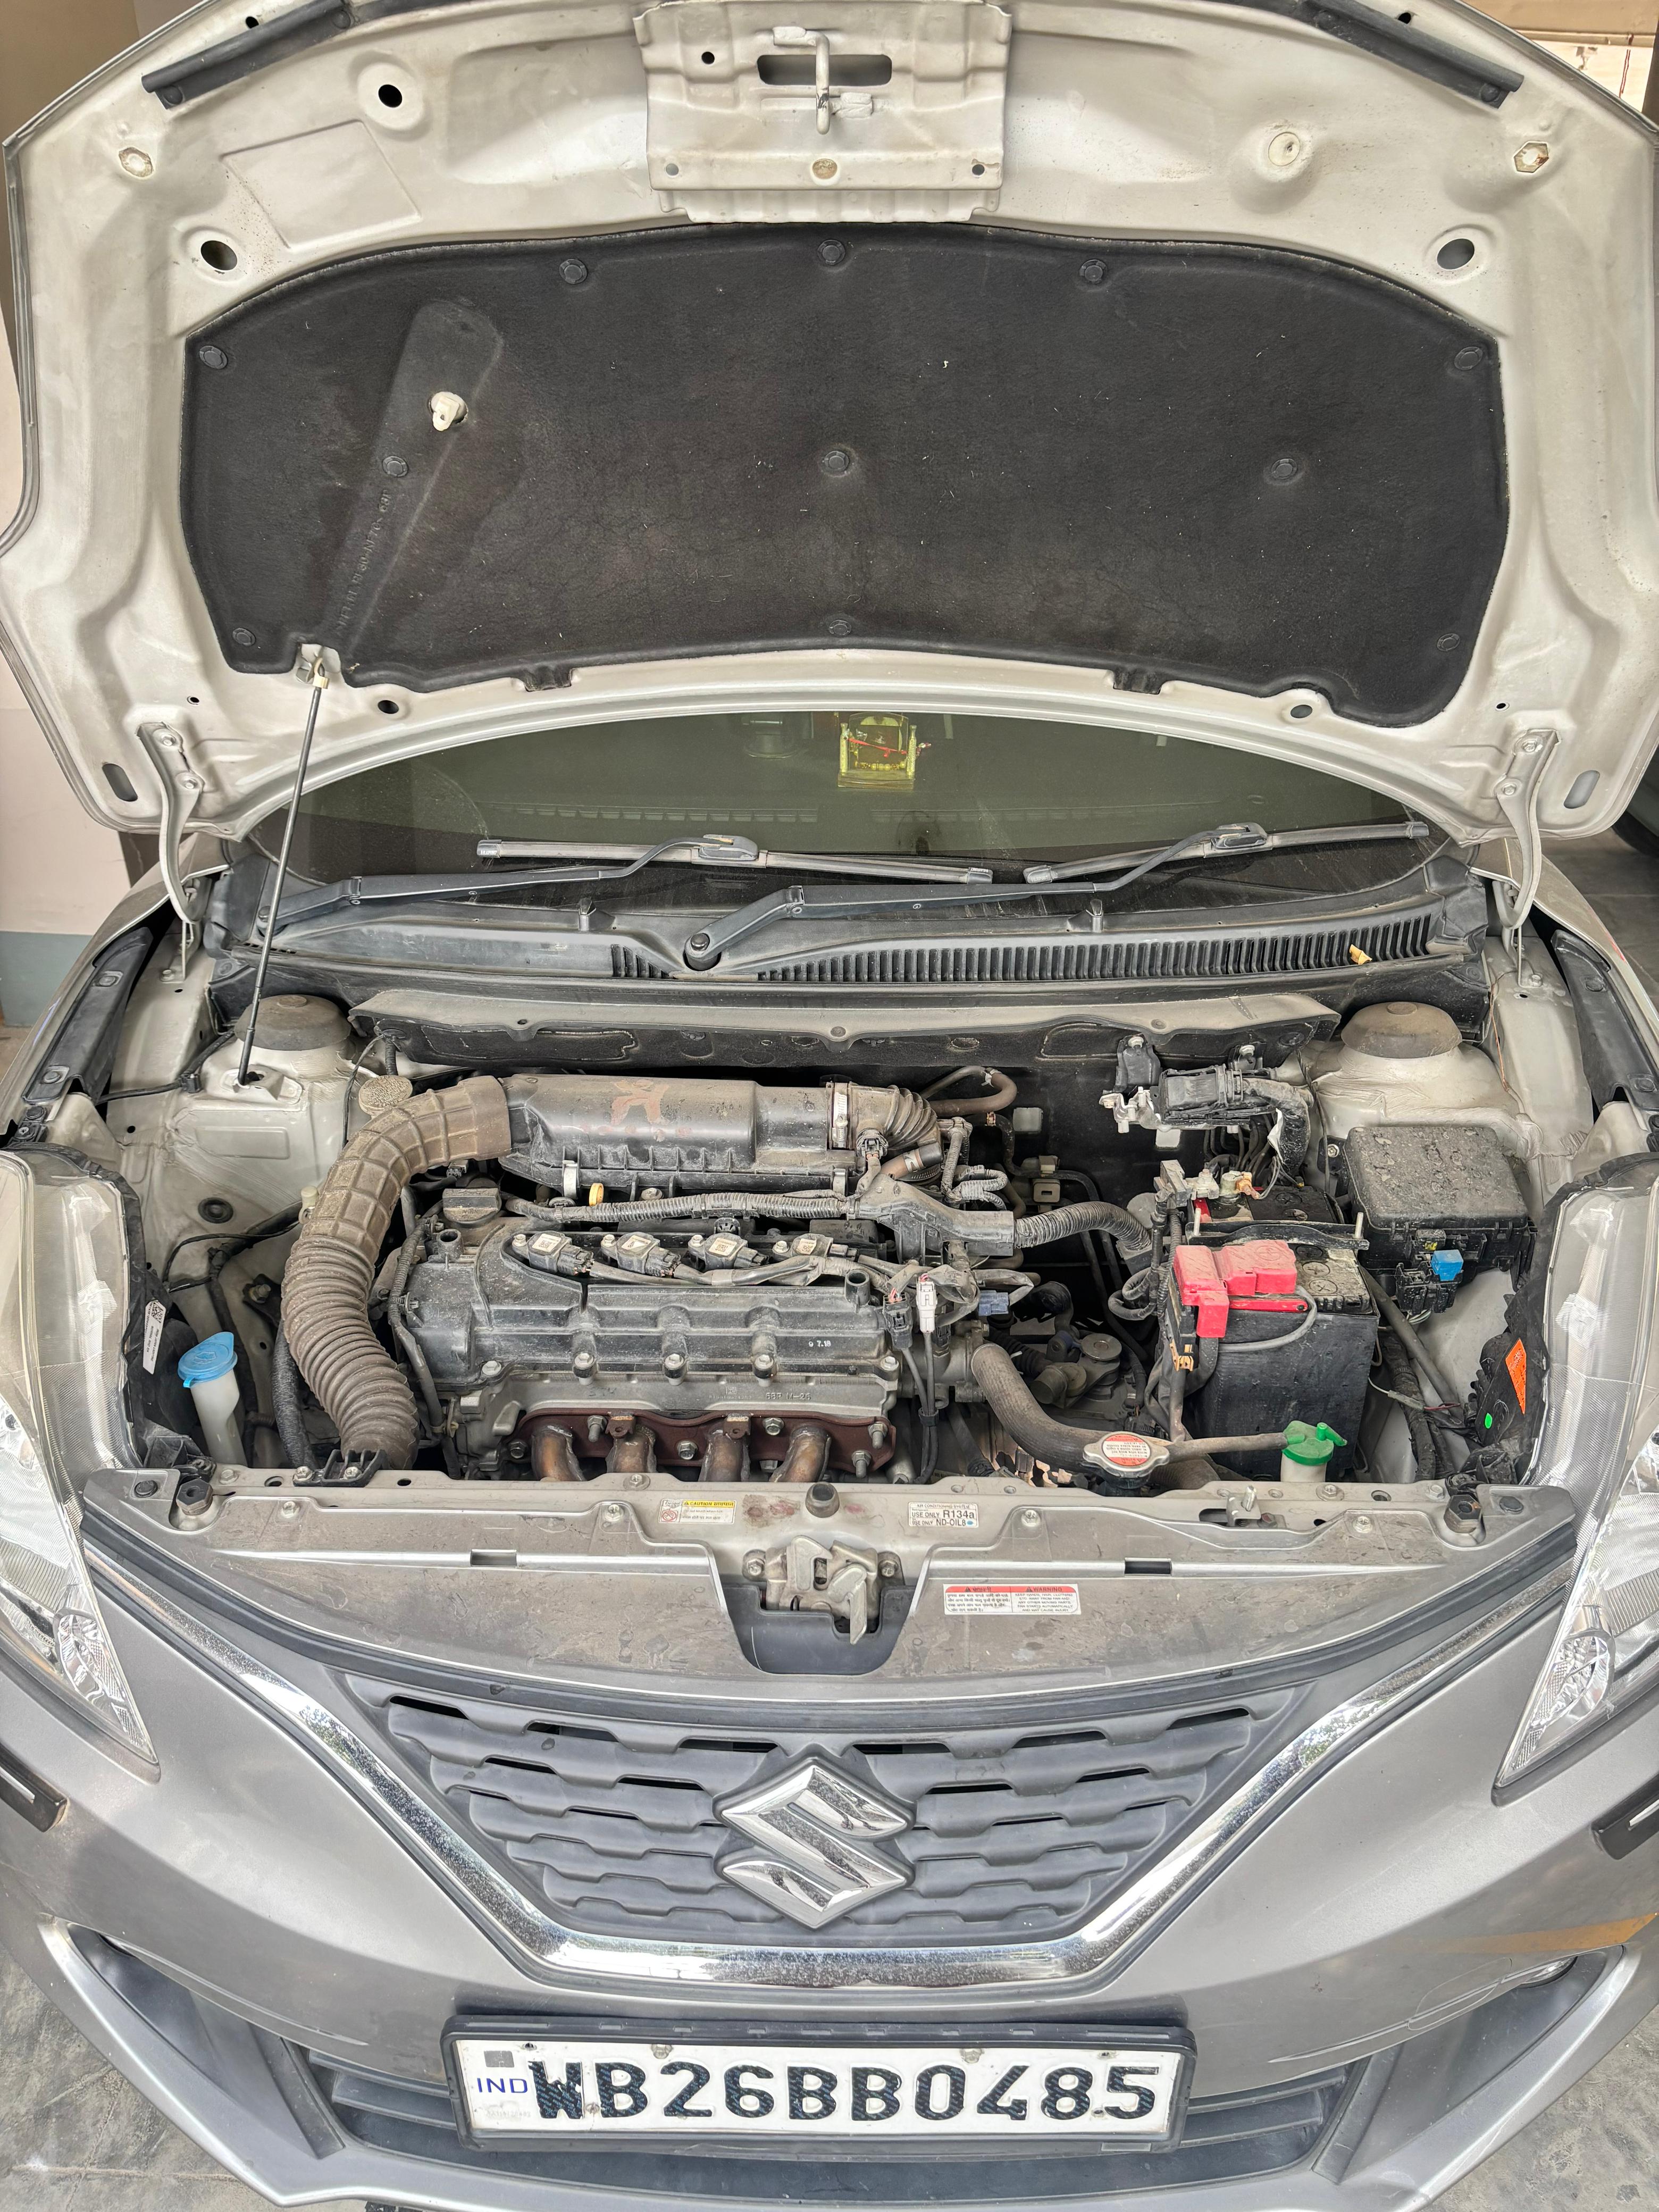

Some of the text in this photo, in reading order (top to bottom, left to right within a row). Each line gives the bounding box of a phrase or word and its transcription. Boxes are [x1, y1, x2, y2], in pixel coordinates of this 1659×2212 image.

[943, 1510, 975, 1519] R134a
[476, 2077, 529, 2094] IND
[527, 2060, 1160, 2122] WB26BB0485
